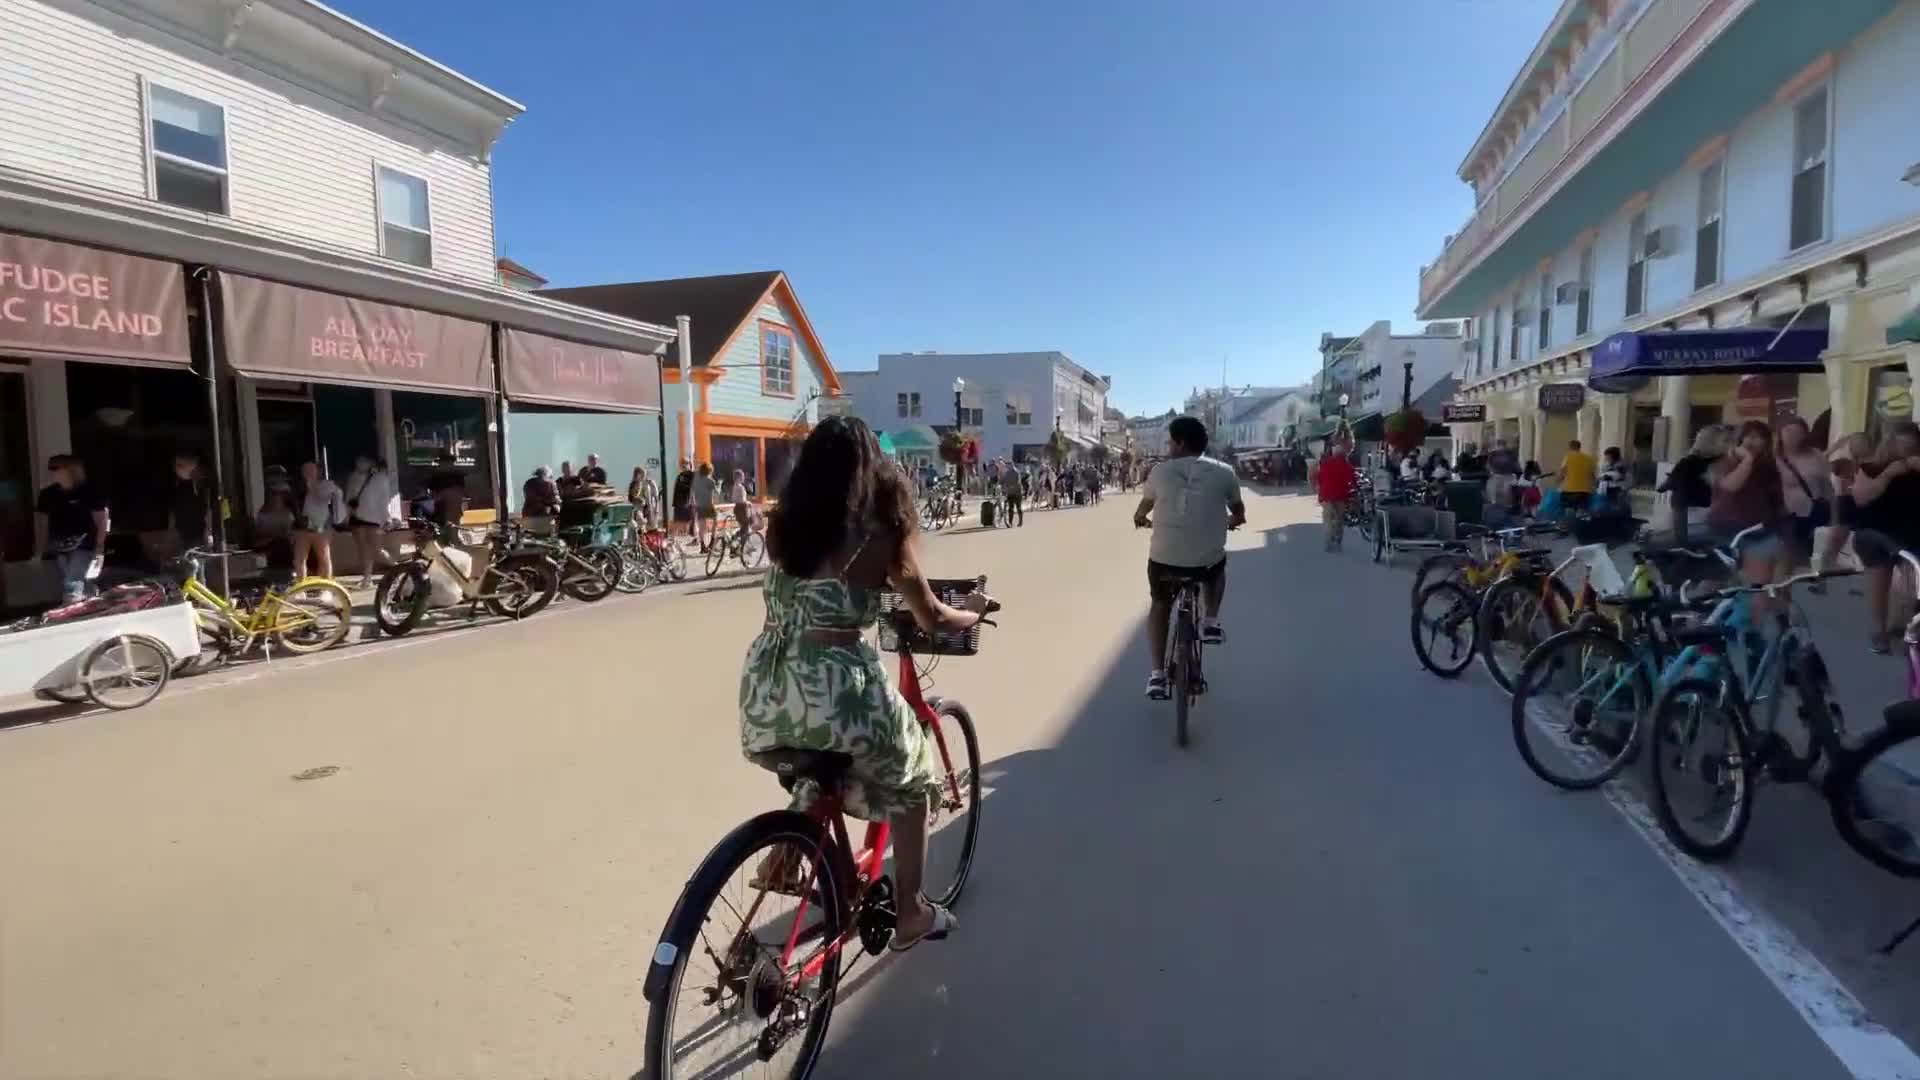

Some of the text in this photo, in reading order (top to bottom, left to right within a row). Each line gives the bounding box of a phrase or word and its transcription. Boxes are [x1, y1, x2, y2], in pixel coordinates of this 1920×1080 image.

[0, 262, 111, 300] FUDGE
[0, 297, 162, 337] C ISLAND
[325, 318, 411, 345] ALL DAY
[311, 337, 425, 369] BREAKFAST
